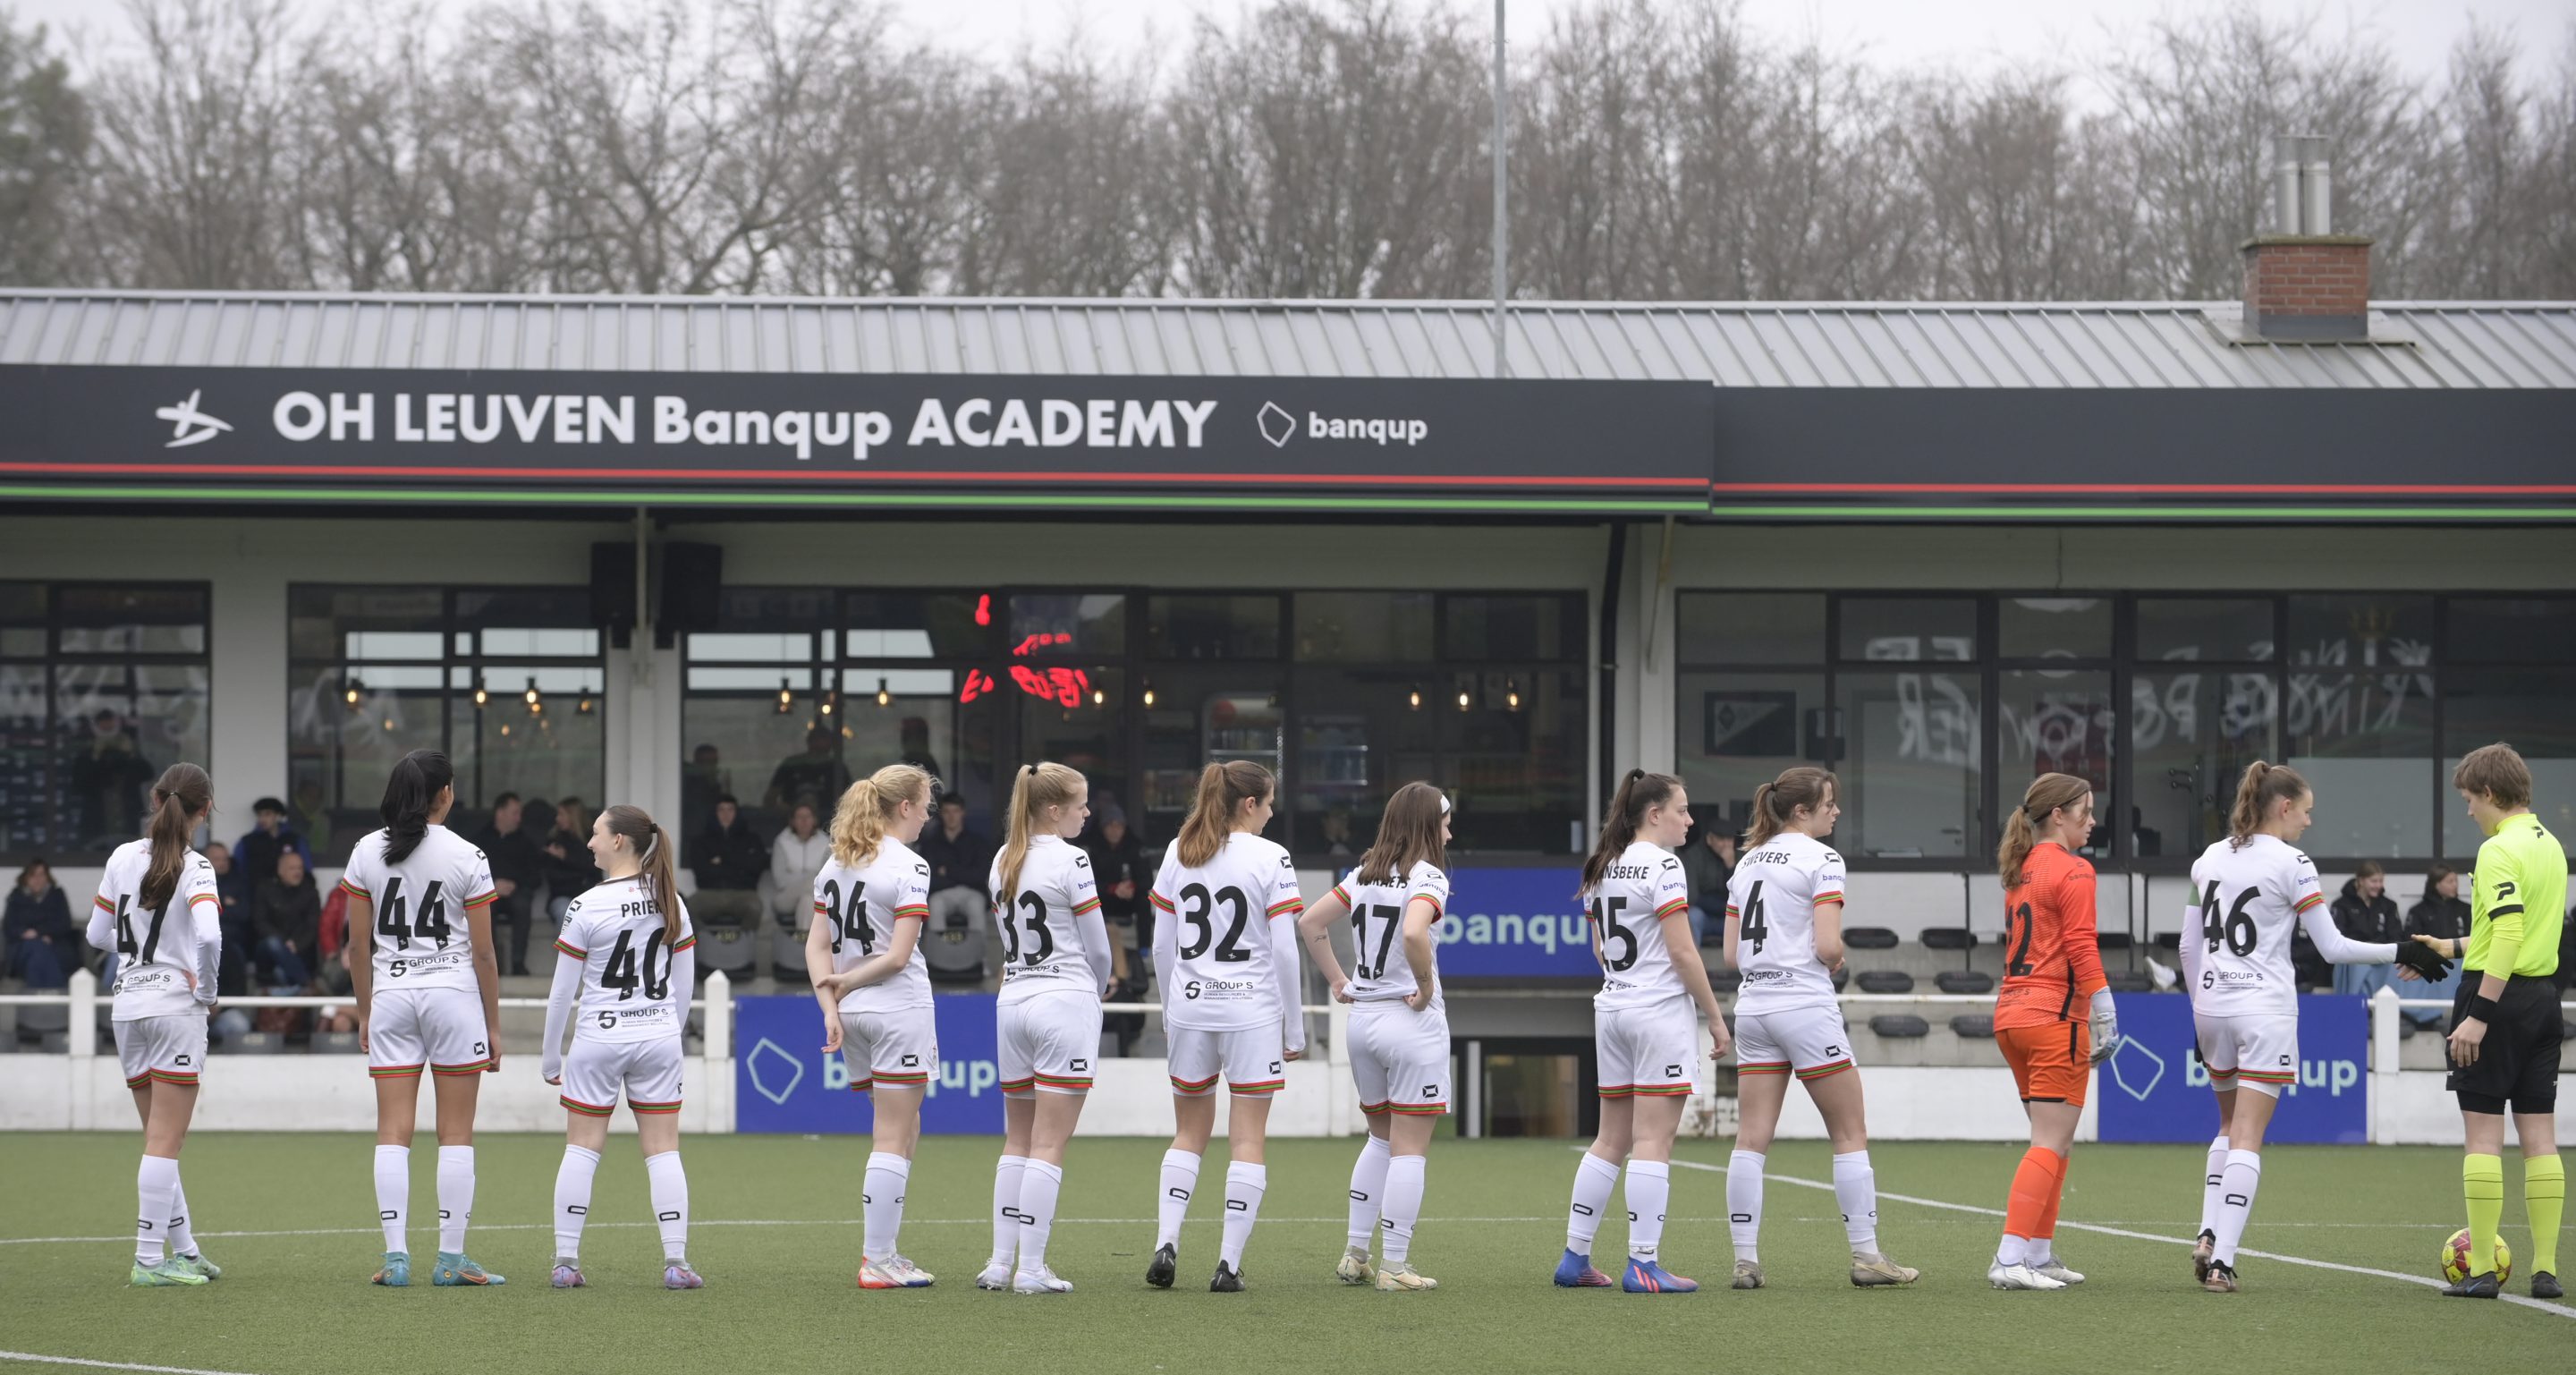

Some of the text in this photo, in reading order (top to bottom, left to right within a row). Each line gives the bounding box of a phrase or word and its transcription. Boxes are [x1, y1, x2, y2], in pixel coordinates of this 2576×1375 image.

[274, 391, 1218, 460] OH LEUVEN Banqup ACADEMY
[1309, 412, 1428, 446] banqup
[1603, 865, 1649, 879] NSBEKE
[117, 894, 172, 967] 47
[377, 877, 451, 952] 44
[823, 878, 876, 956] 34
[996, 889, 1054, 966] 33
[1179, 882, 1251, 963] 32
[1351, 902, 1401, 980] 17
[1591, 895, 1638, 973] 15
[1740, 879, 1767, 956] 4
[2201, 879, 2261, 958] 46
[601, 927, 674, 1002] 40
[1205, 981, 1243, 989] GROUP
[1246, 981, 1253, 989] S
[823, 1052, 996, 1099] bup
[2185, 1048, 2359, 1097] bup
